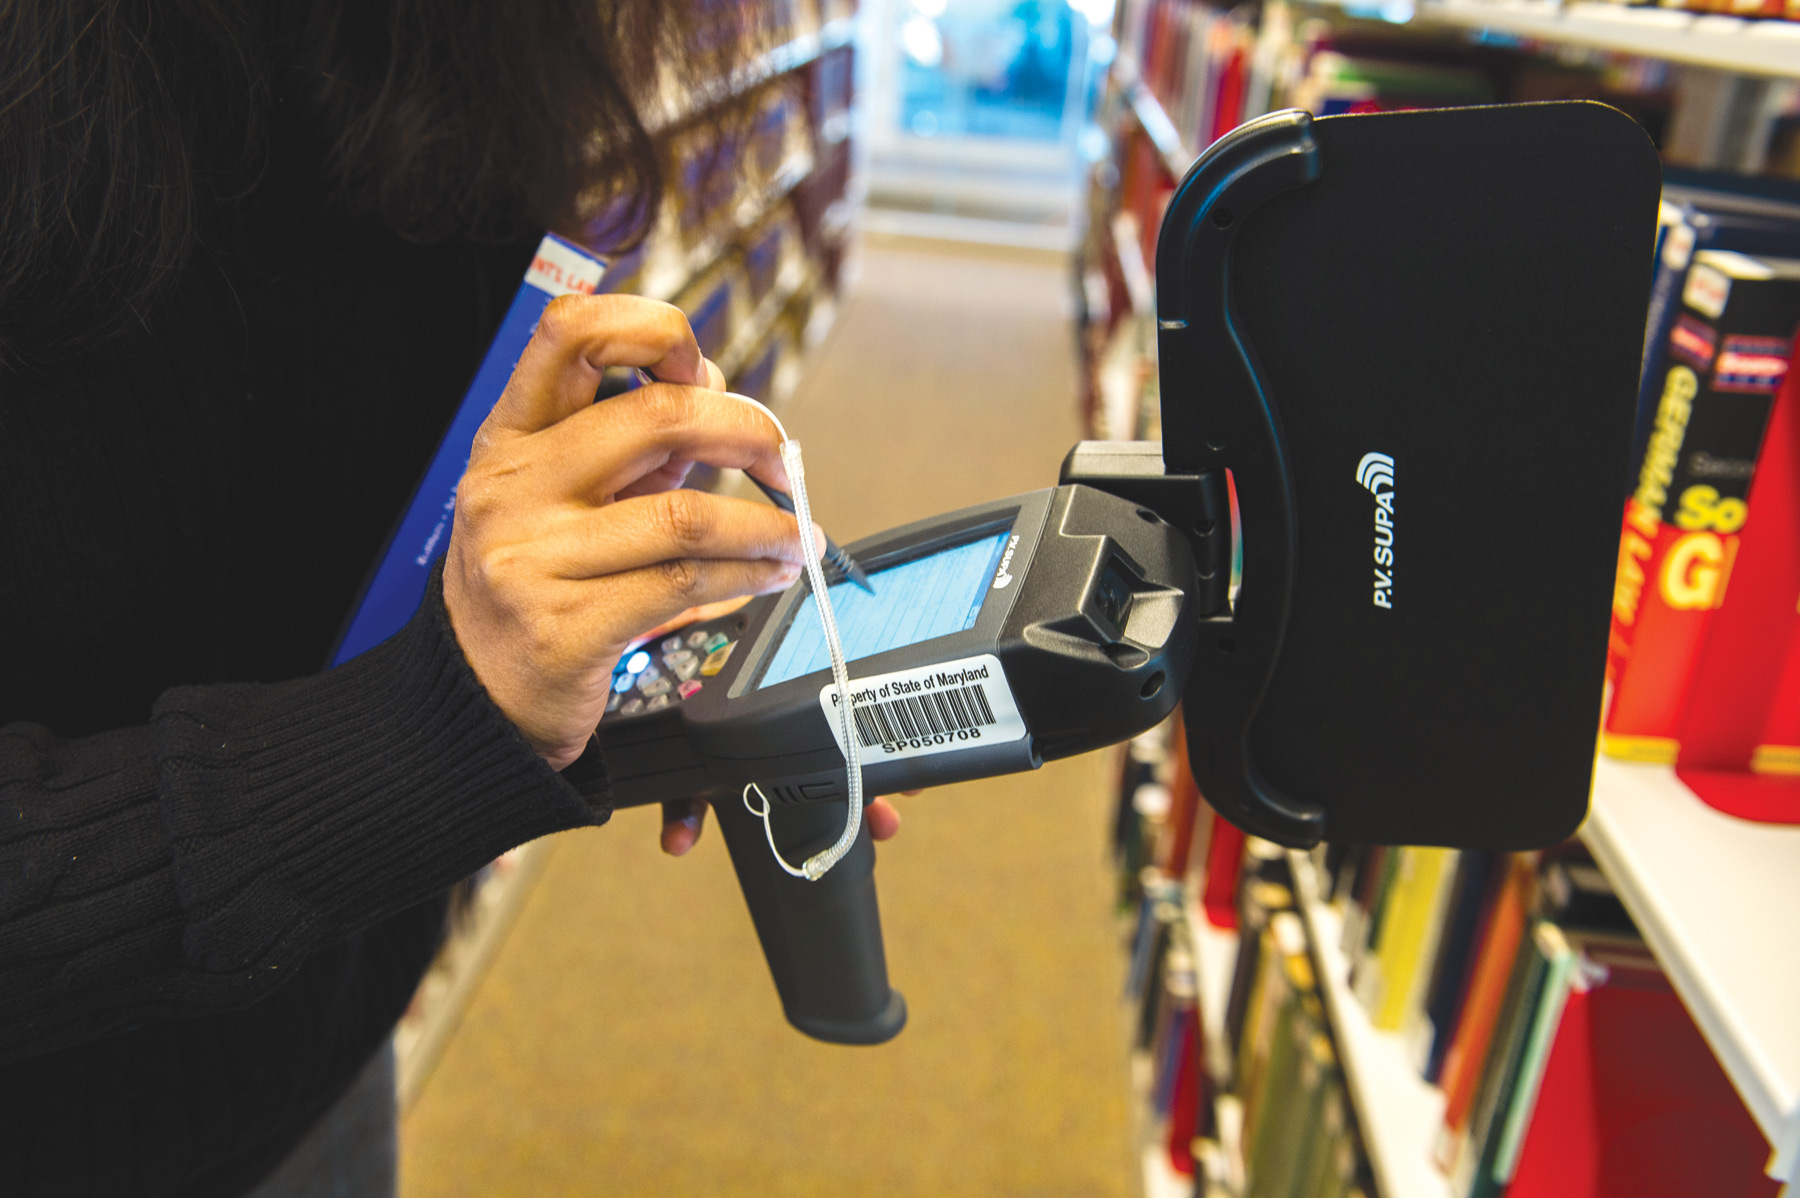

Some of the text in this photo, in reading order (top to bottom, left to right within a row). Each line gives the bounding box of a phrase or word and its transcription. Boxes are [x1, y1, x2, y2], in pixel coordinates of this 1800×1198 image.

[831, 664, 989, 707] Pperty of State of Maryland
[882, 727, 981, 754] SP050708
